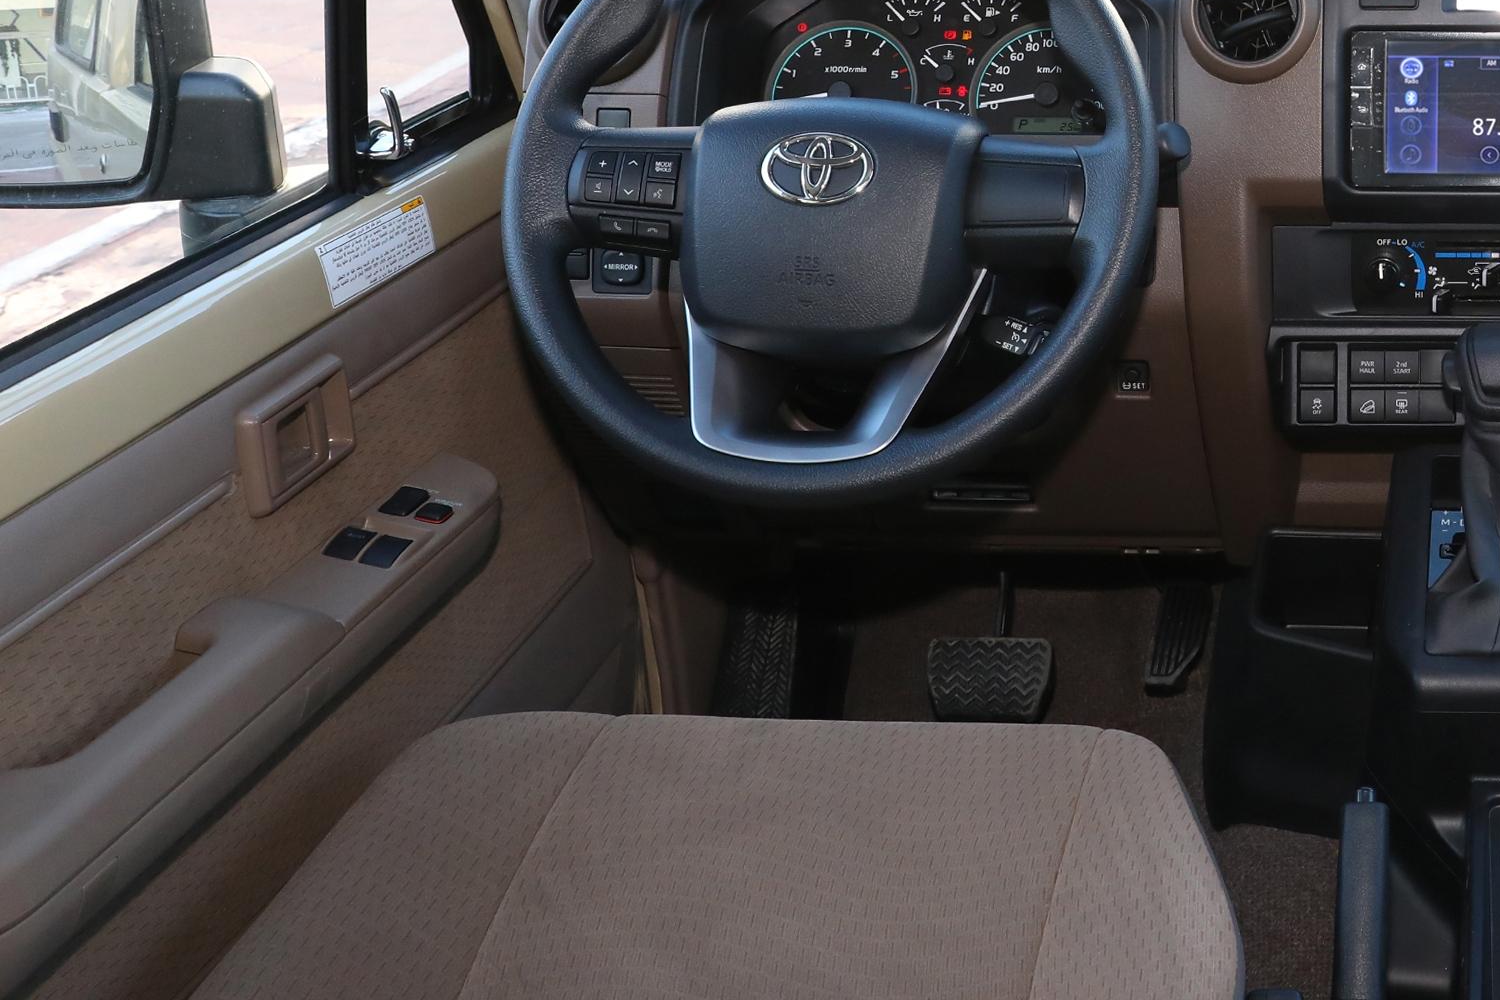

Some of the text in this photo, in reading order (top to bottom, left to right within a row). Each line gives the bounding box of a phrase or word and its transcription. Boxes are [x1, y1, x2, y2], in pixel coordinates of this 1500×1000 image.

[933, 14, 941, 22] H
[963, 14, 971, 22] E
[1010, 14, 1019, 22] F
[844, 39, 852, 48] 3
[1025, 43, 1040, 52] 80
[813, 47, 822, 56] 2
[871, 48, 880, 56] 4
[967, 57, 975, 66] H
[1010, 52, 1025, 62] 60
[792, 69, 797, 78] 1
[995, 65, 1011, 75] 40
[1036, 65, 1062, 73] km/h
[890, 70, 899, 79] 5
[989, 83, 1004, 92] 20
[1018, 120, 1028, 129] P
[1376, 238, 1408, 246] OFF LO
[1411, 240, 1425, 249] A/C
[1010, 322, 1023, 331] RES
[1002, 341, 1014, 350] SET
[1132, 382, 1145, 390] SET
